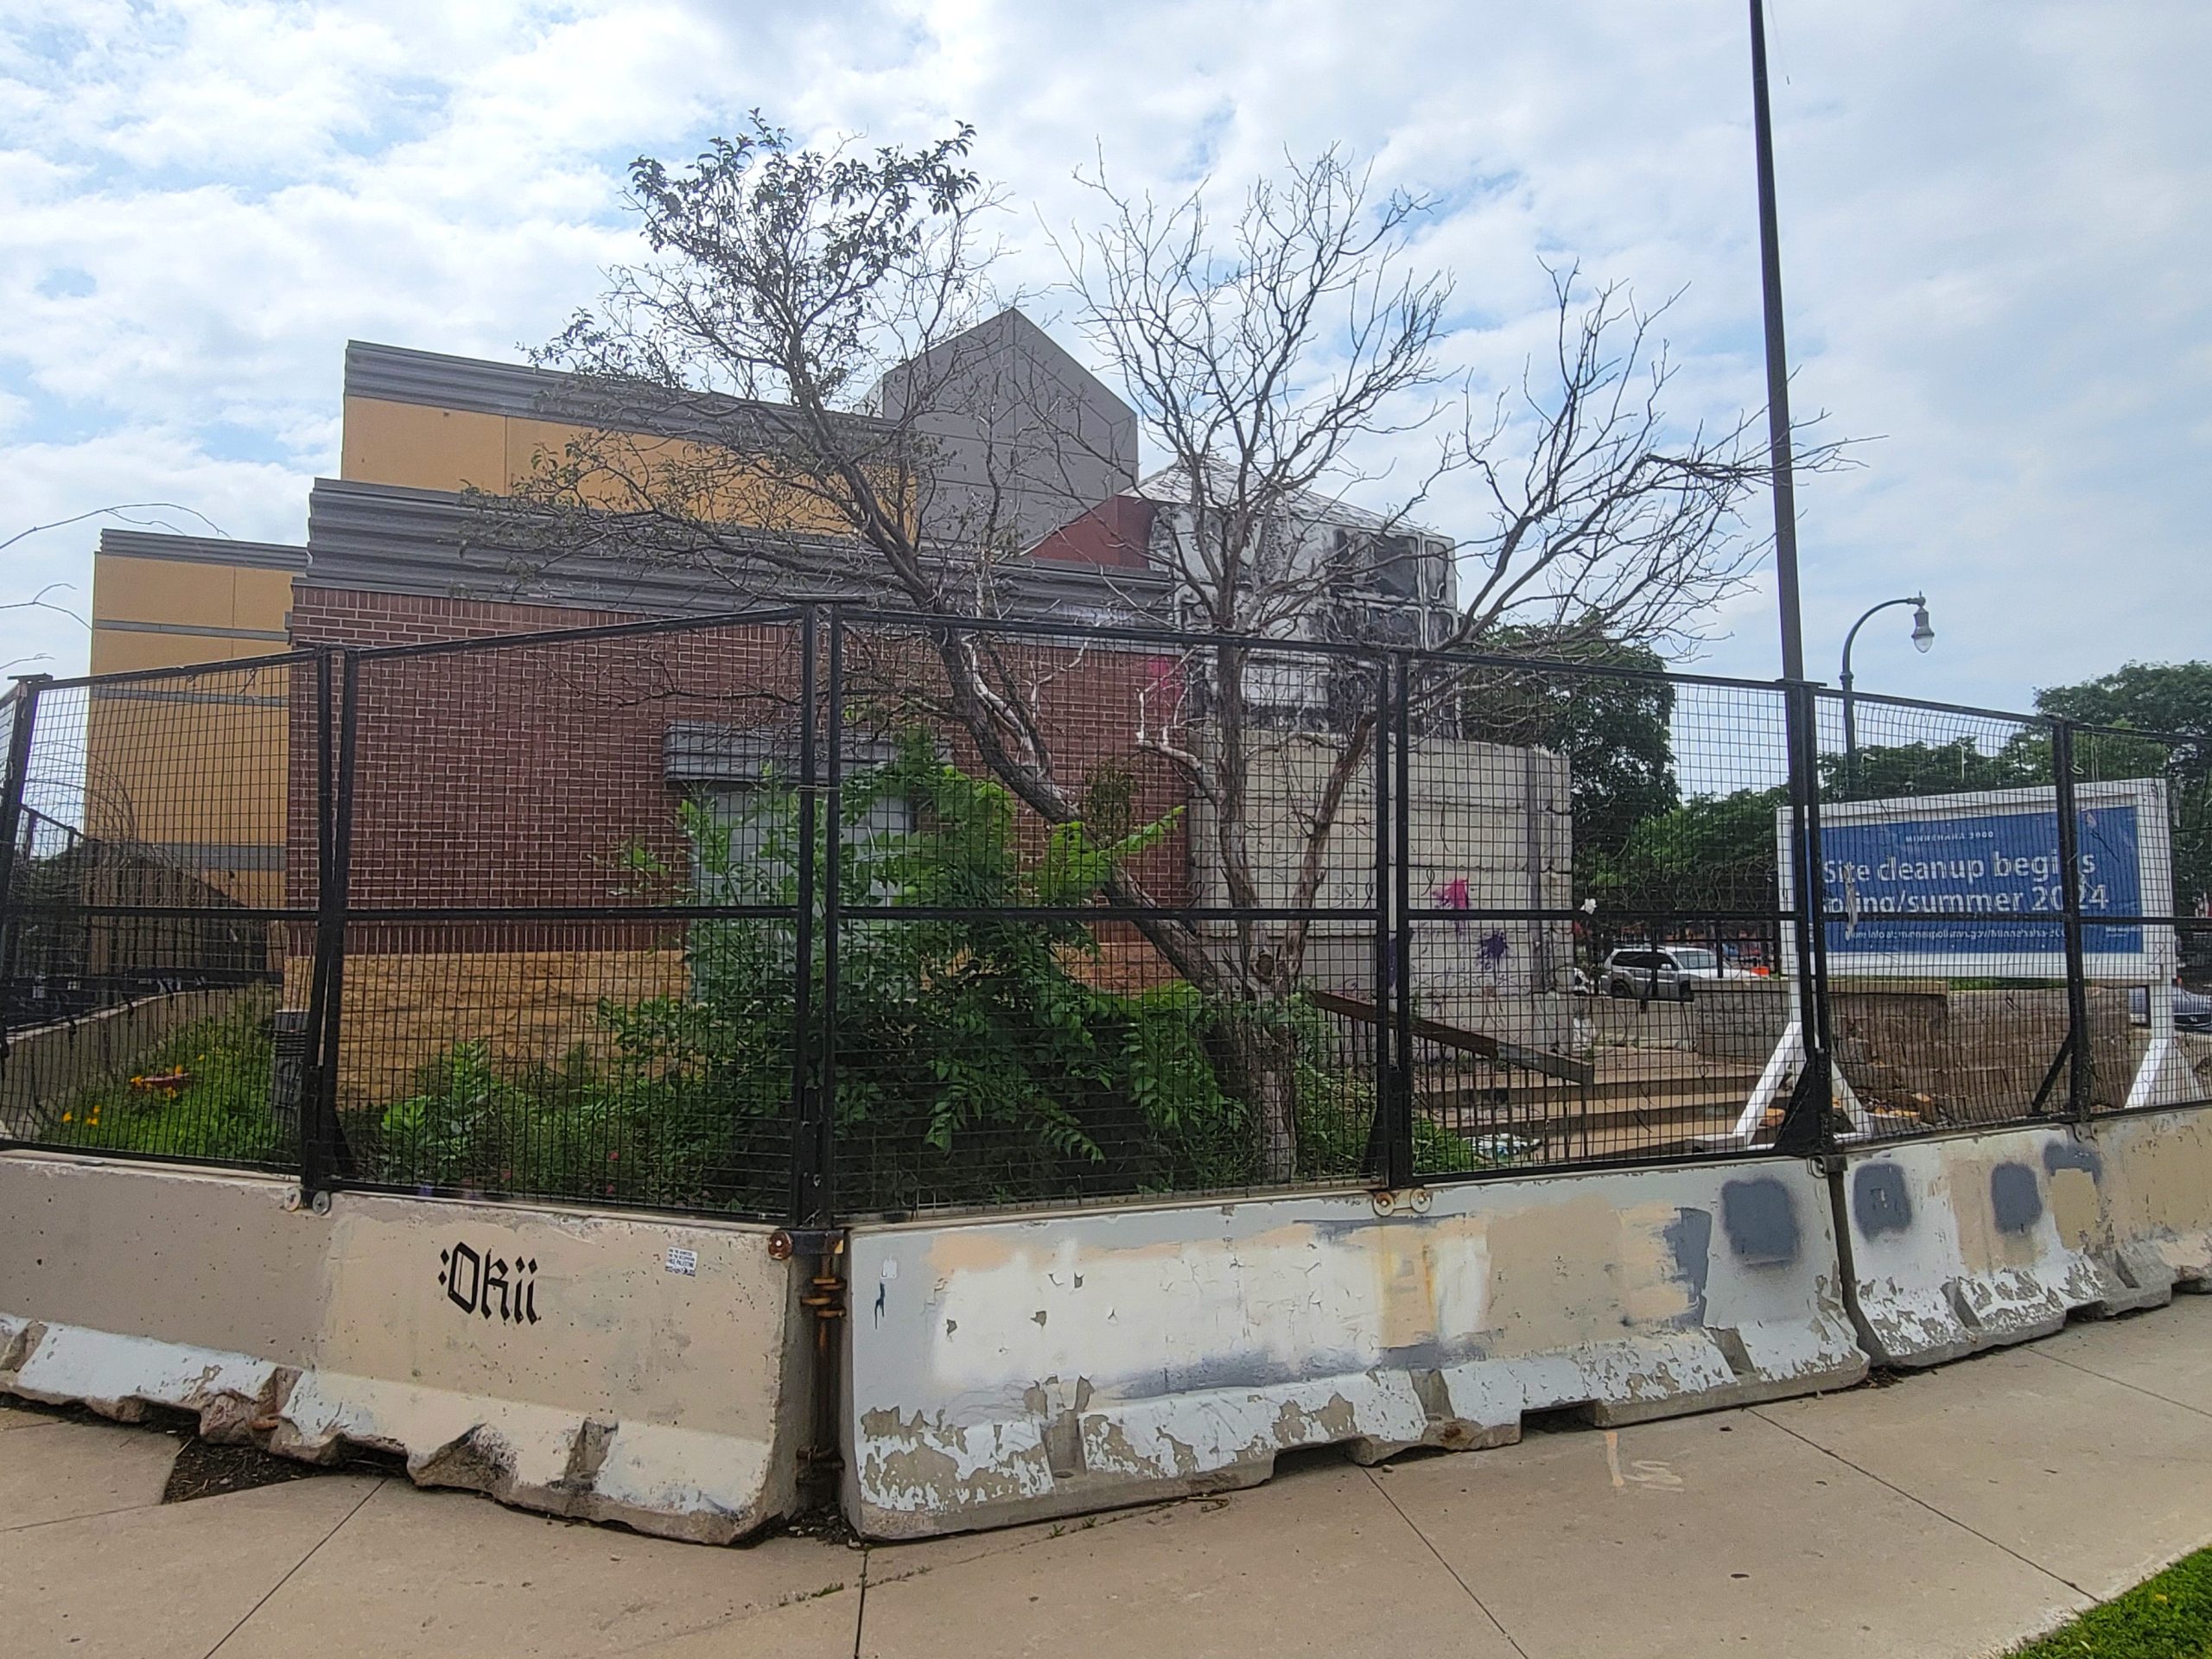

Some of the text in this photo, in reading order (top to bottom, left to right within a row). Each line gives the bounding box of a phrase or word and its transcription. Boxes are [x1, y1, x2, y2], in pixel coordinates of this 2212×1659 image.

[1824, 849, 2095, 885] Site cleanup begis
